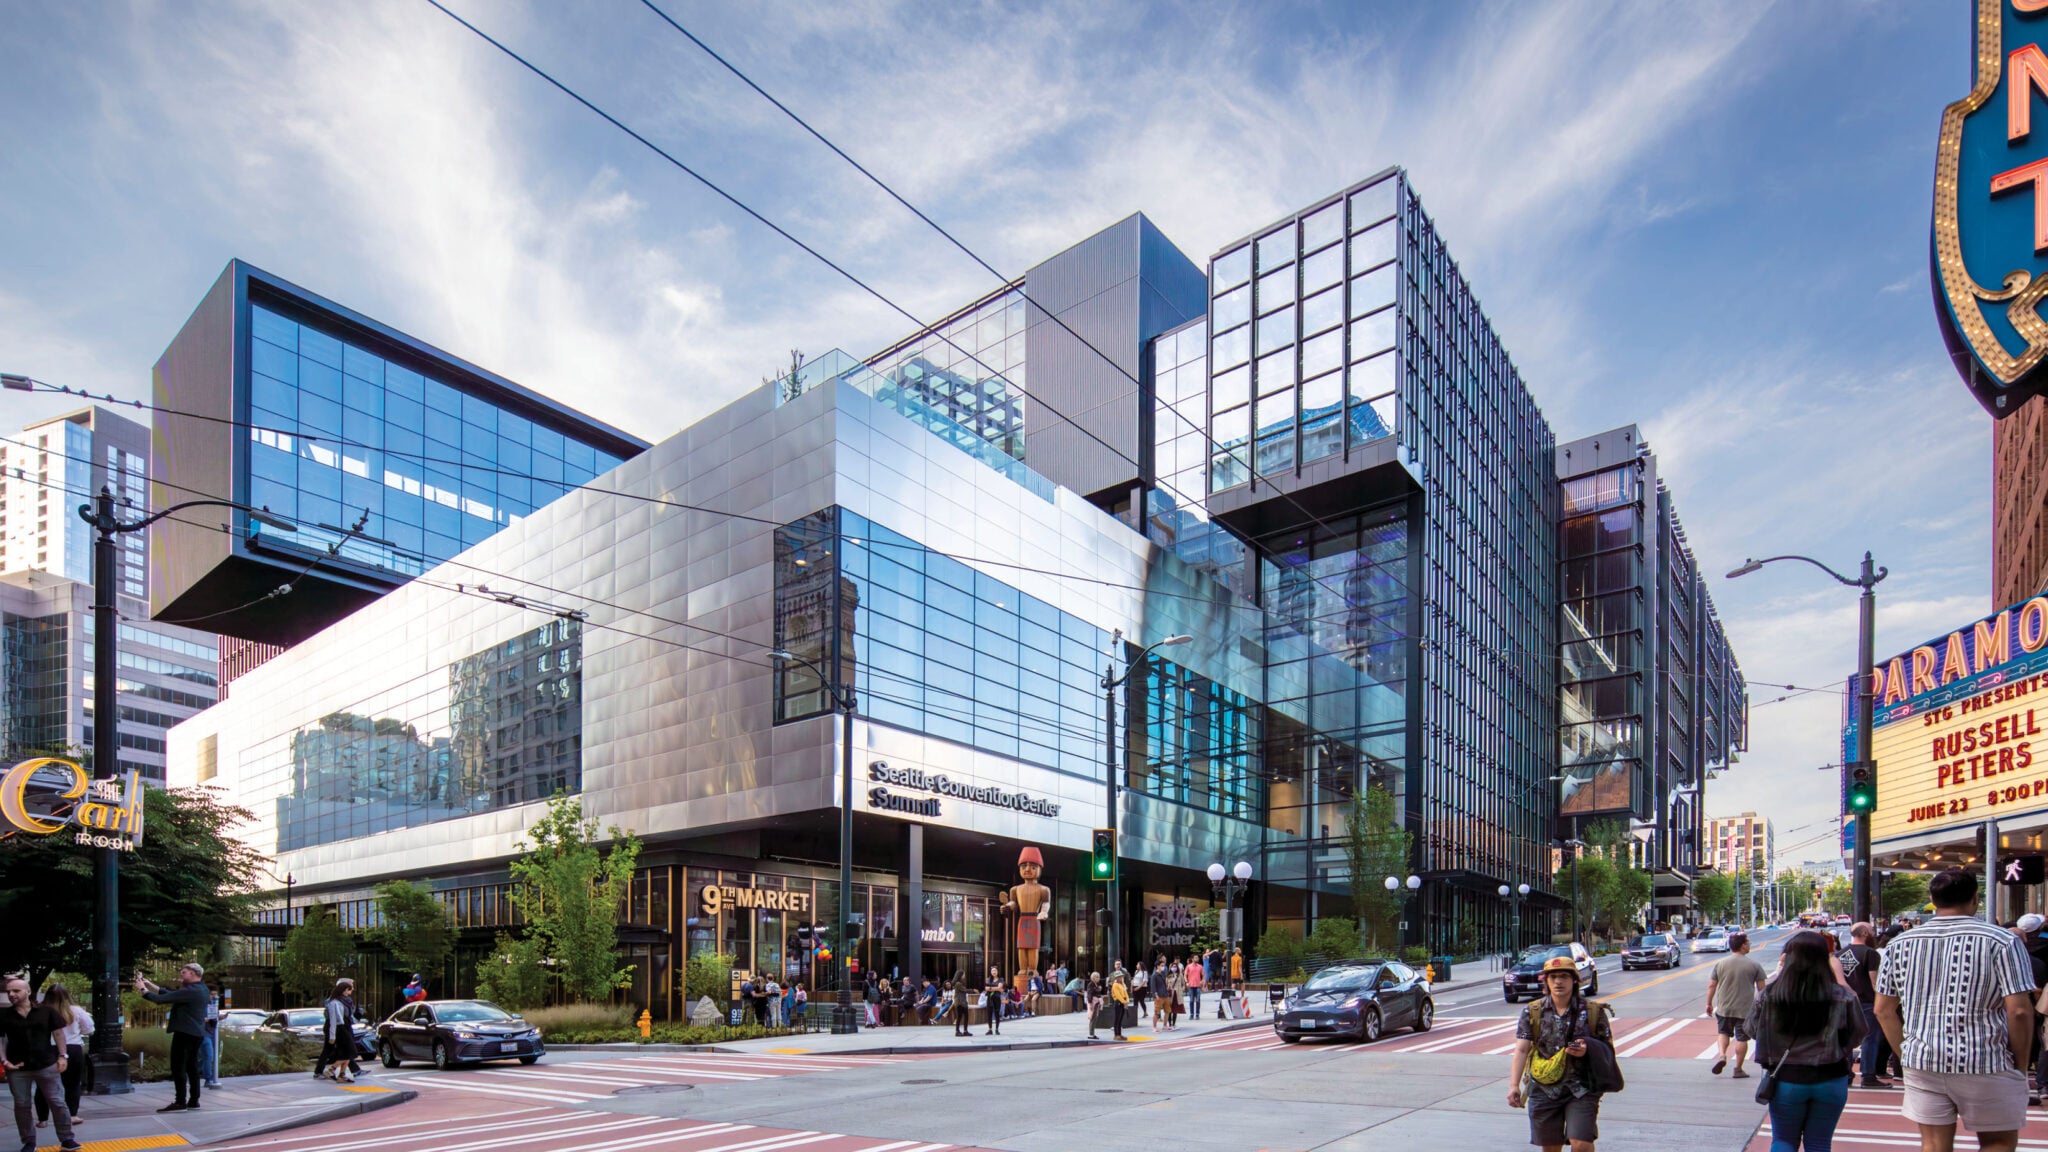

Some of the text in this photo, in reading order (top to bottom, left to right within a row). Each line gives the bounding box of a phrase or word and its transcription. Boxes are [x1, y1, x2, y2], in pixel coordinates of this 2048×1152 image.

[1991, 0, 2048, 256] NT
[1924, 671, 2048, 727] STG PRESENTS
[1933, 709, 2041, 761] RUSSELL
[1938, 742, 2032, 789] PETERS
[0, 757, 144, 836] Carli
[94, 774, 121, 802] THE
[869, 787, 941, 817] Summit
[870, 760, 1061, 817] Seattle Convention Center
[1907, 802, 1946, 823] JUNE
[1949, 797, 1969, 815] 23
[75, 833, 133, 852] ROOM
[736, 887, 809, 912] MARKET
[1149, 932, 1195, 946] Center
